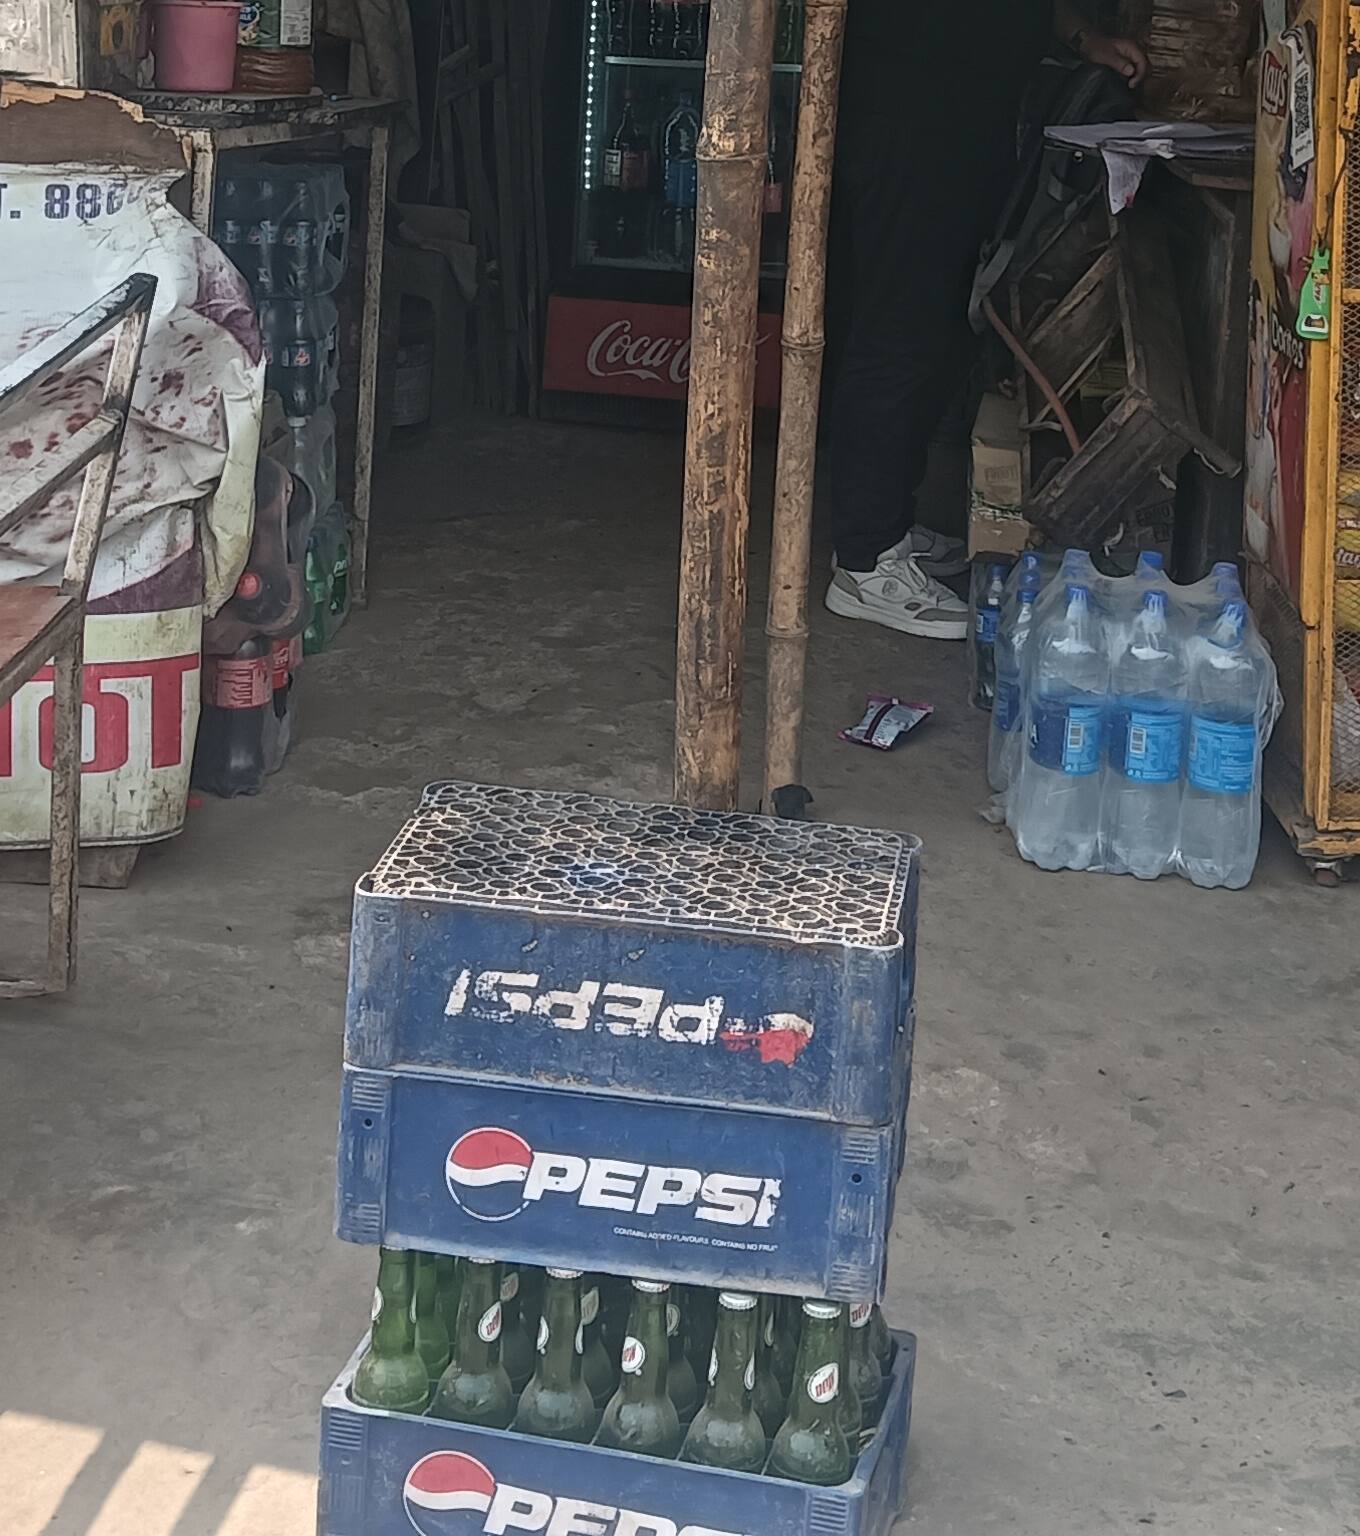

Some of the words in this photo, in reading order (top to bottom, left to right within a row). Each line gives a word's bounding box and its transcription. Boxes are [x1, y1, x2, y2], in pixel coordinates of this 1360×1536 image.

[585, 318, 691, 385] Coca-C
[443, 969, 725, 1048] PEPSI
[522, 1150, 782, 1228] PEPSI
